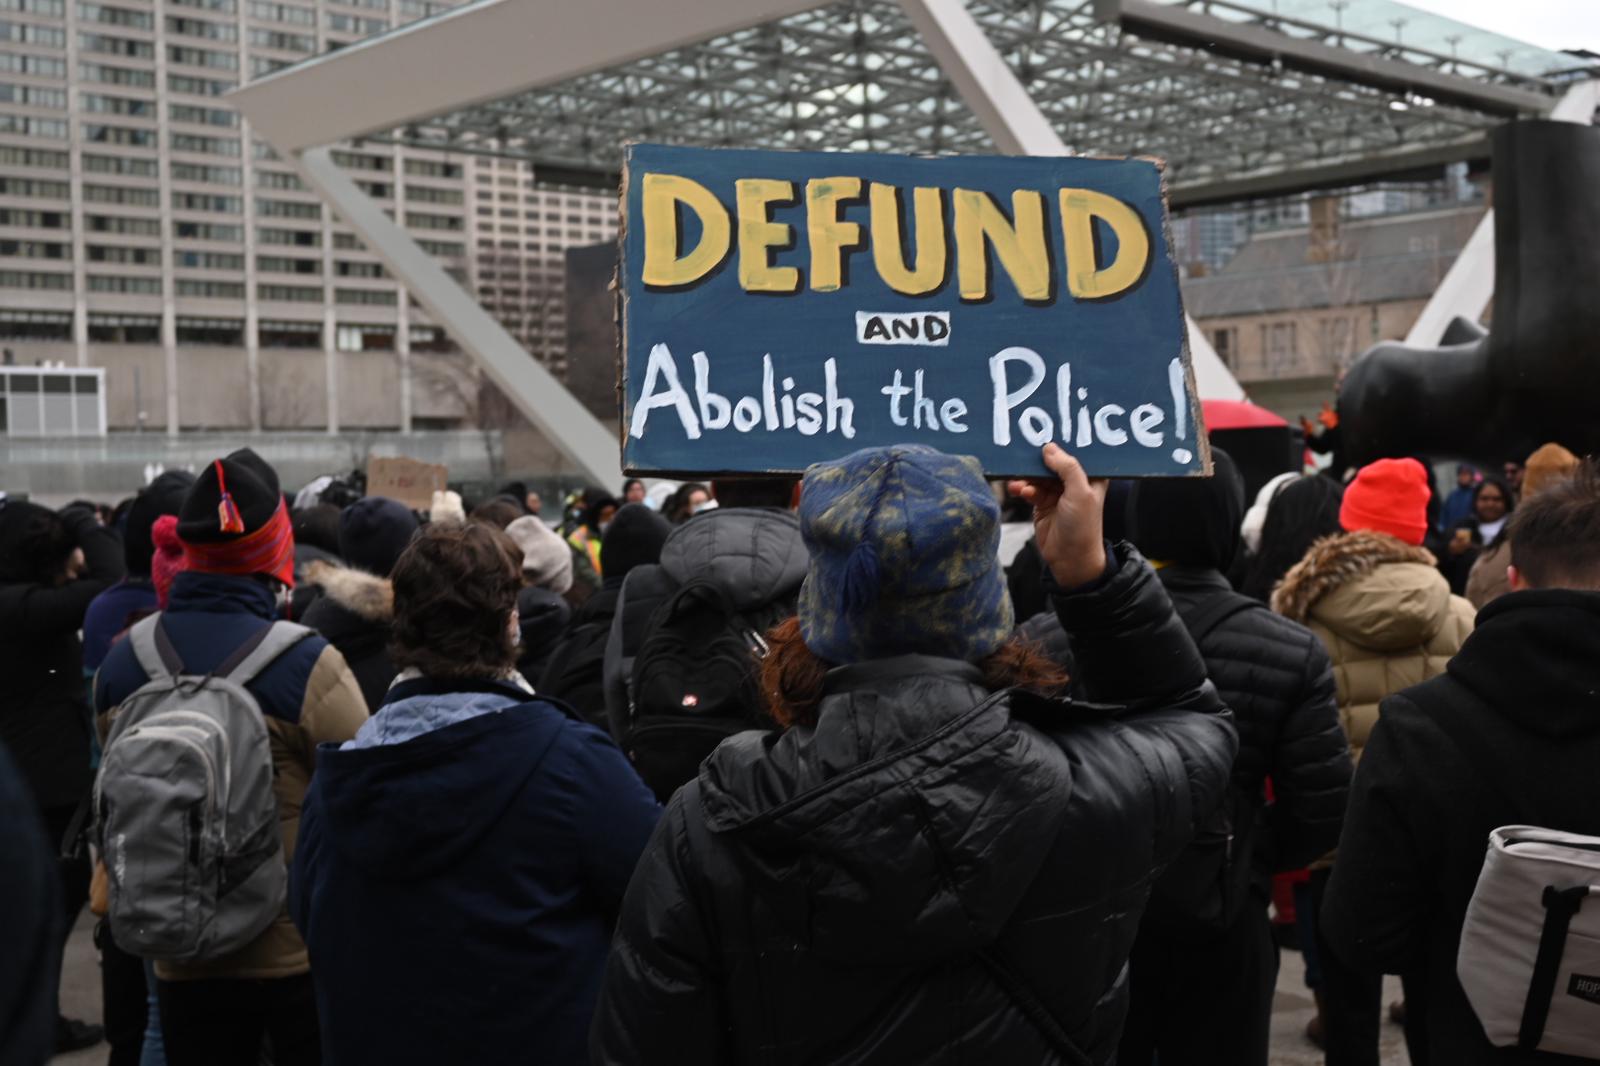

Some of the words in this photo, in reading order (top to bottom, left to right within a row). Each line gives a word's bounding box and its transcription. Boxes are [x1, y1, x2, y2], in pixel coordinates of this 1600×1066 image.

[641, 172, 1151, 301] DEFUND
[863, 315, 950, 342] AND
[629, 342, 856, 441] Abolish
[881, 368, 969, 433] the
[988, 345, 1193, 465] Police!
